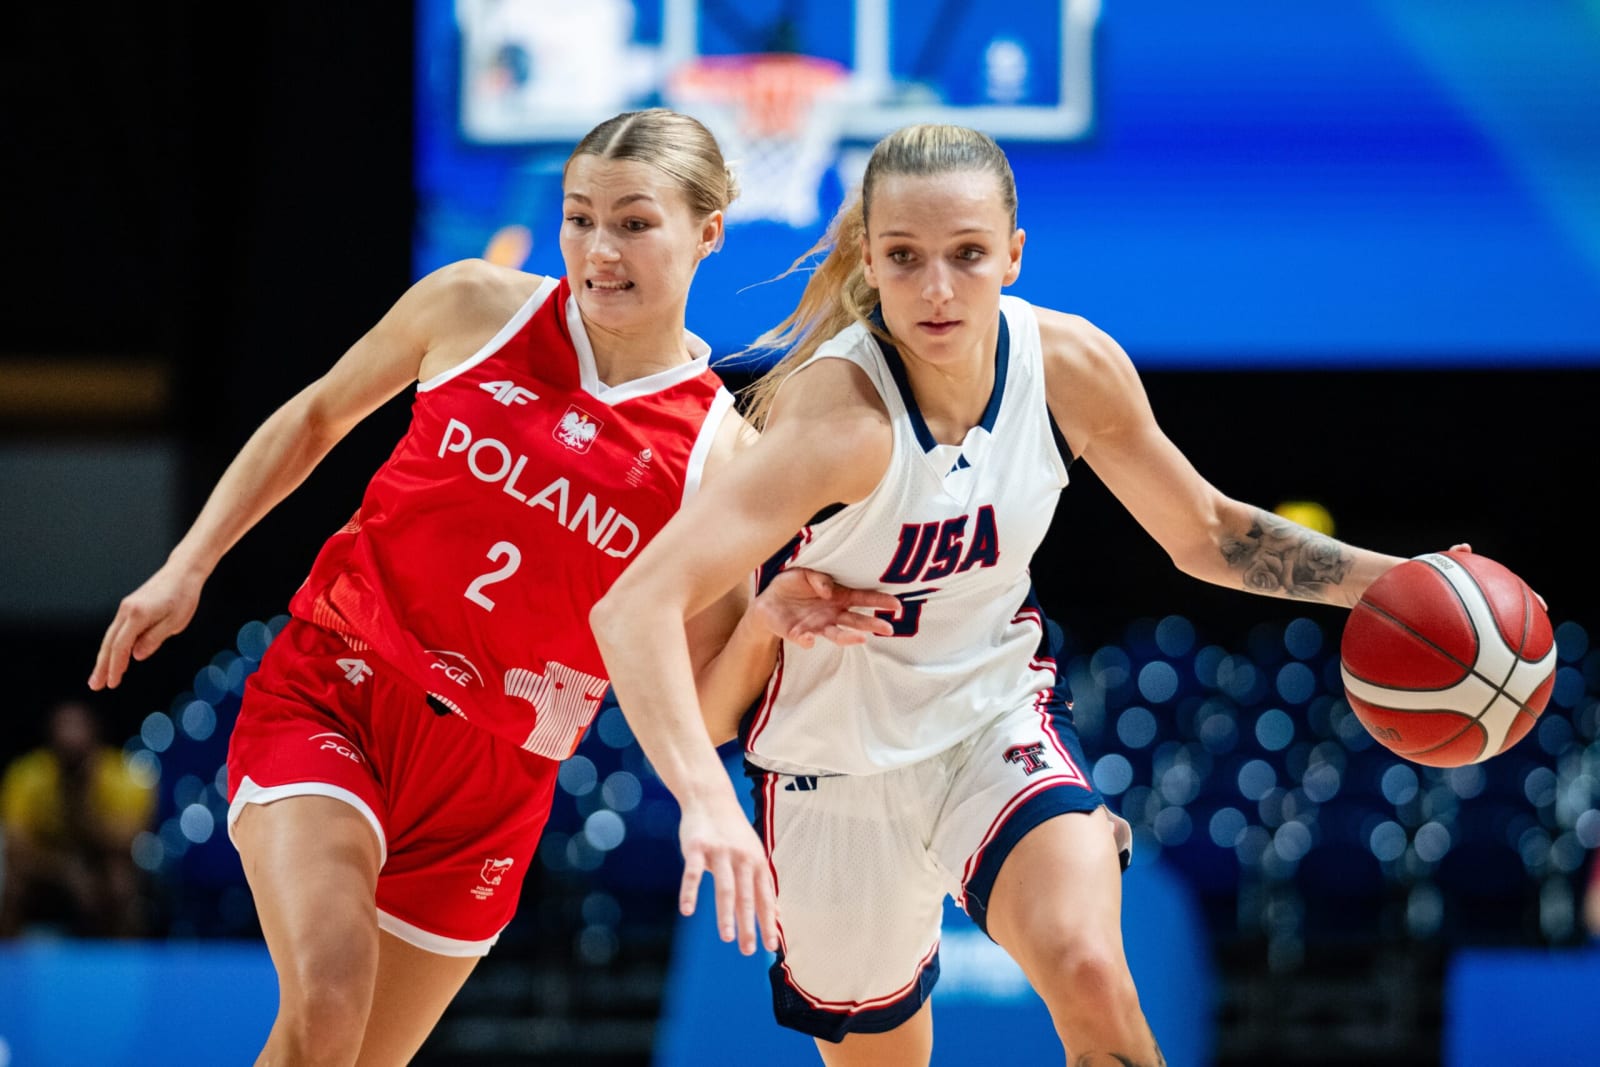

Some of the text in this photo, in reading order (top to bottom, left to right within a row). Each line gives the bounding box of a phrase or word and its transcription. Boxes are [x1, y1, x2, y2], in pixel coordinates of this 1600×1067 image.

[479, 380, 539, 406] 4F
[438, 418, 640, 559] POLAND
[879, 504, 1000, 584] USA
[464, 541, 522, 612] 2
[430, 659, 473, 687] PGE
[320, 740, 360, 763] PGE
